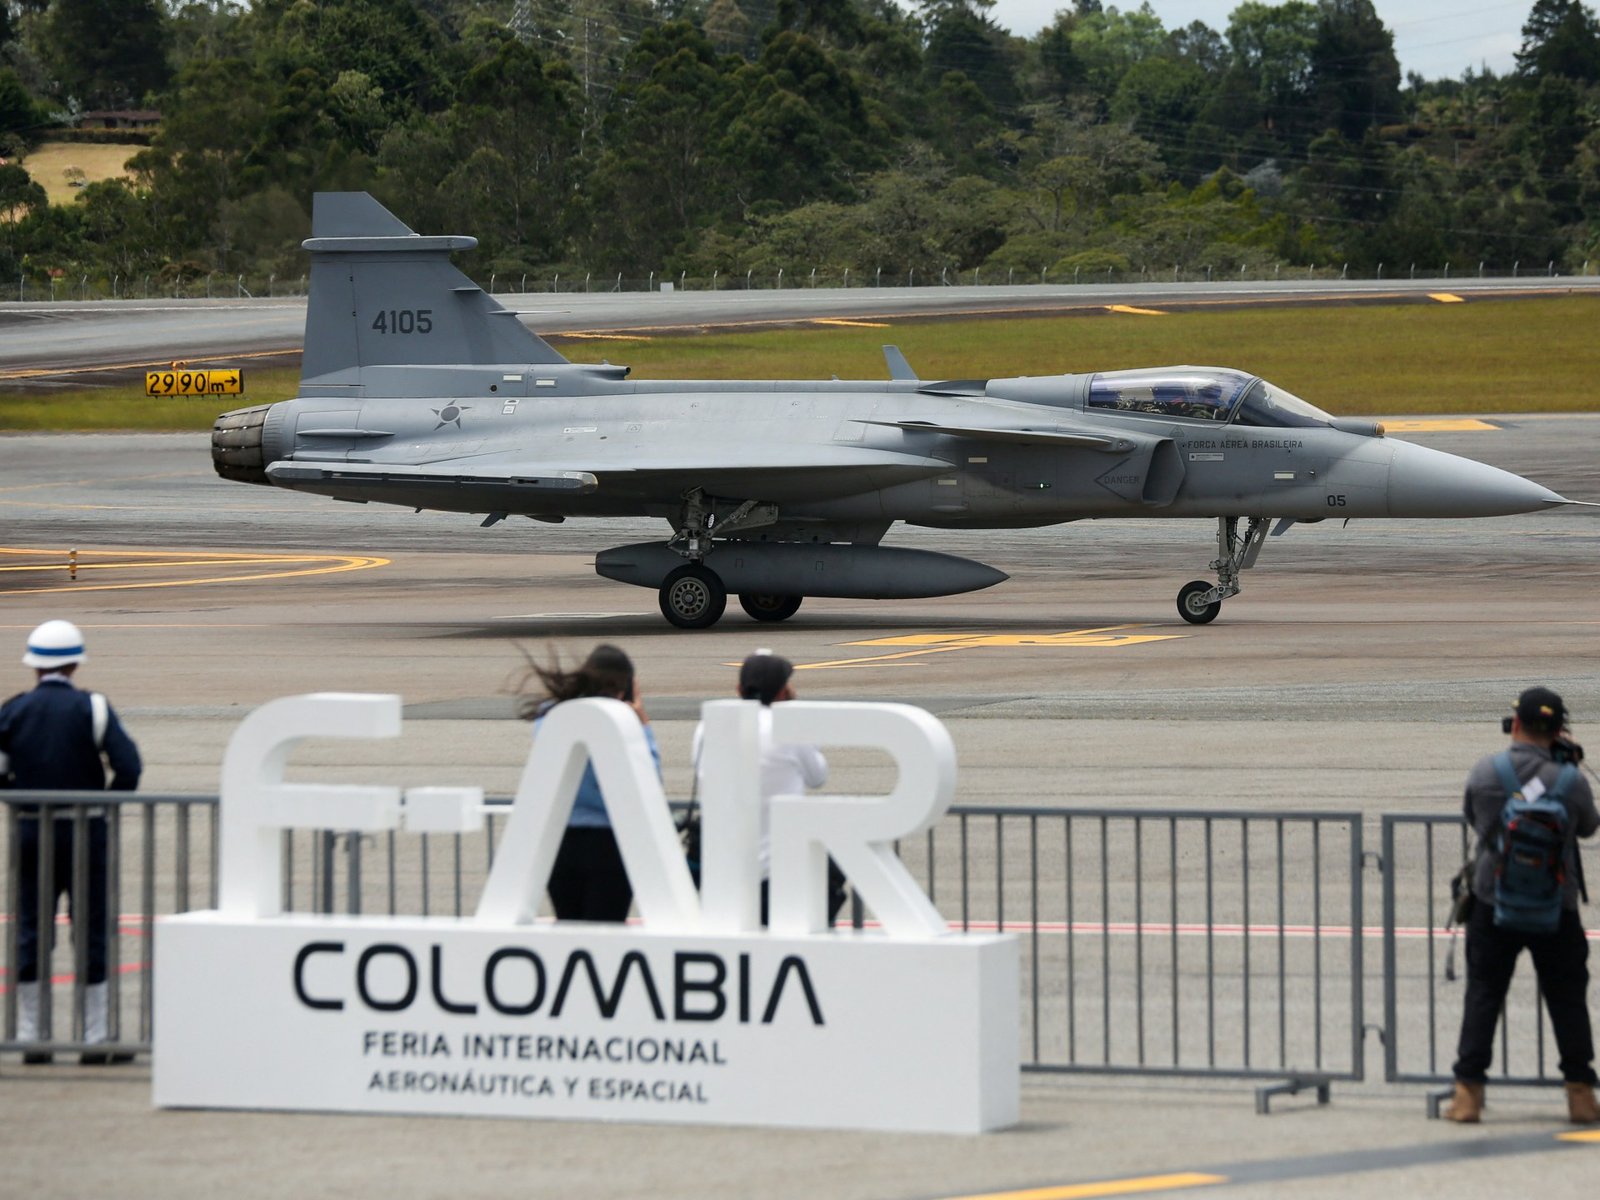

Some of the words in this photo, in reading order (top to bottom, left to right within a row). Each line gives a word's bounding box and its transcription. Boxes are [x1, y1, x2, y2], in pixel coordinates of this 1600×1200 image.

[372, 309, 433, 334] 4105
[211, 382, 225, 392] m
[1252, 440, 1303, 449] BRASILEIRA
[1104, 475, 1140, 485] DANGER
[1327, 495, 1346, 506] 05
[293, 940, 826, 1027] COLOMBIA
[362, 1031, 451, 1059] FERIA
[462, 1034, 728, 1066] INTERNACIONAL
[368, 1068, 554, 1097] AERONÁUTICA
[563, 1077, 579, 1098] Y
[588, 1077, 709, 1104] ESPACIAL
